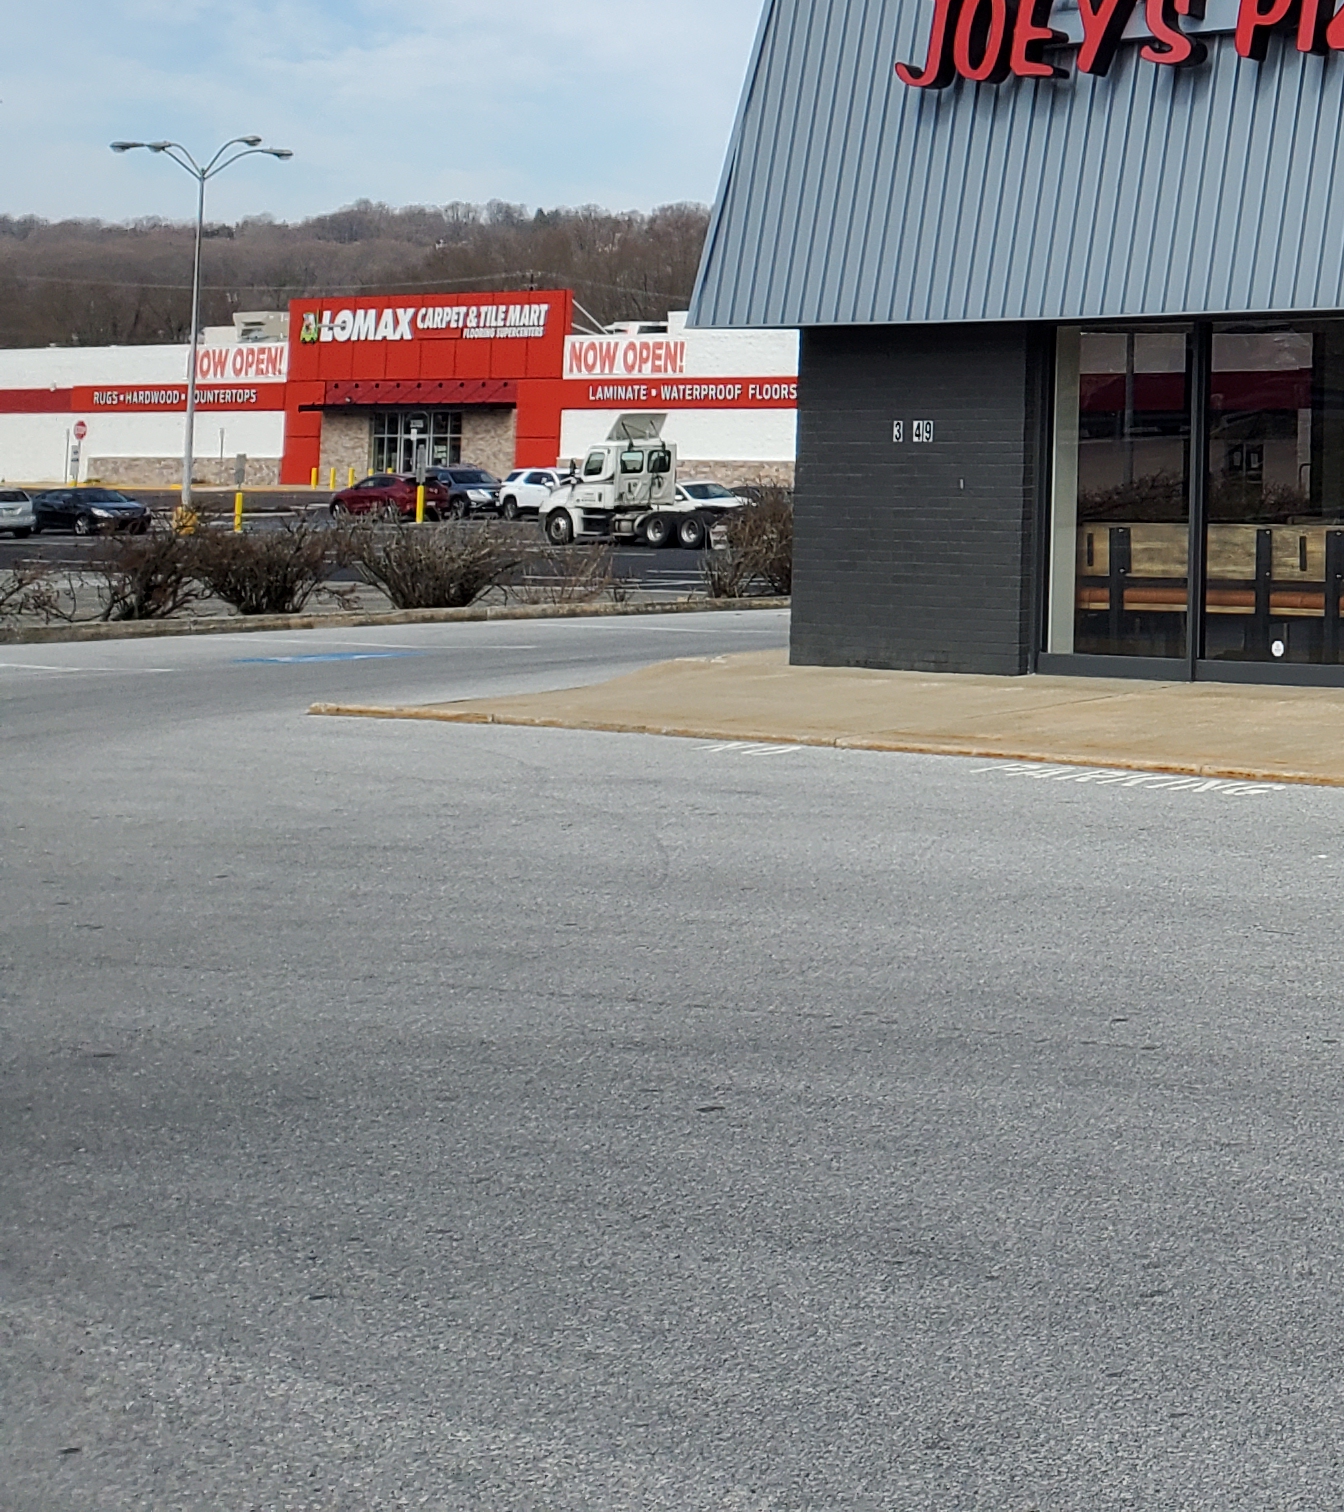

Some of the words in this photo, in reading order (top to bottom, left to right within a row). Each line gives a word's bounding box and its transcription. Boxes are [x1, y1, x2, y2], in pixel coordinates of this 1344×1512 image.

[319, 308, 415, 342] LOMAX
[416, 306, 467, 329] CARPET
[467, 306, 477, 327] &
[479, 305, 507, 327] TILE
[507, 304, 549, 326] MART
[232, 346, 285, 378] OPEN!
[569, 341, 619, 374] NOW
[622, 341, 685, 374] OPEN!
[93, 391, 119, 405] RUGS
[125, 390, 180, 405] HARDWOOD
[193, 389, 257, 404] OUNTERTOPS
[589, 385, 647, 401] LAMINATE
[660, 384, 742, 401] WATERPROOF
[748, 383, 797, 400] FLOORS
